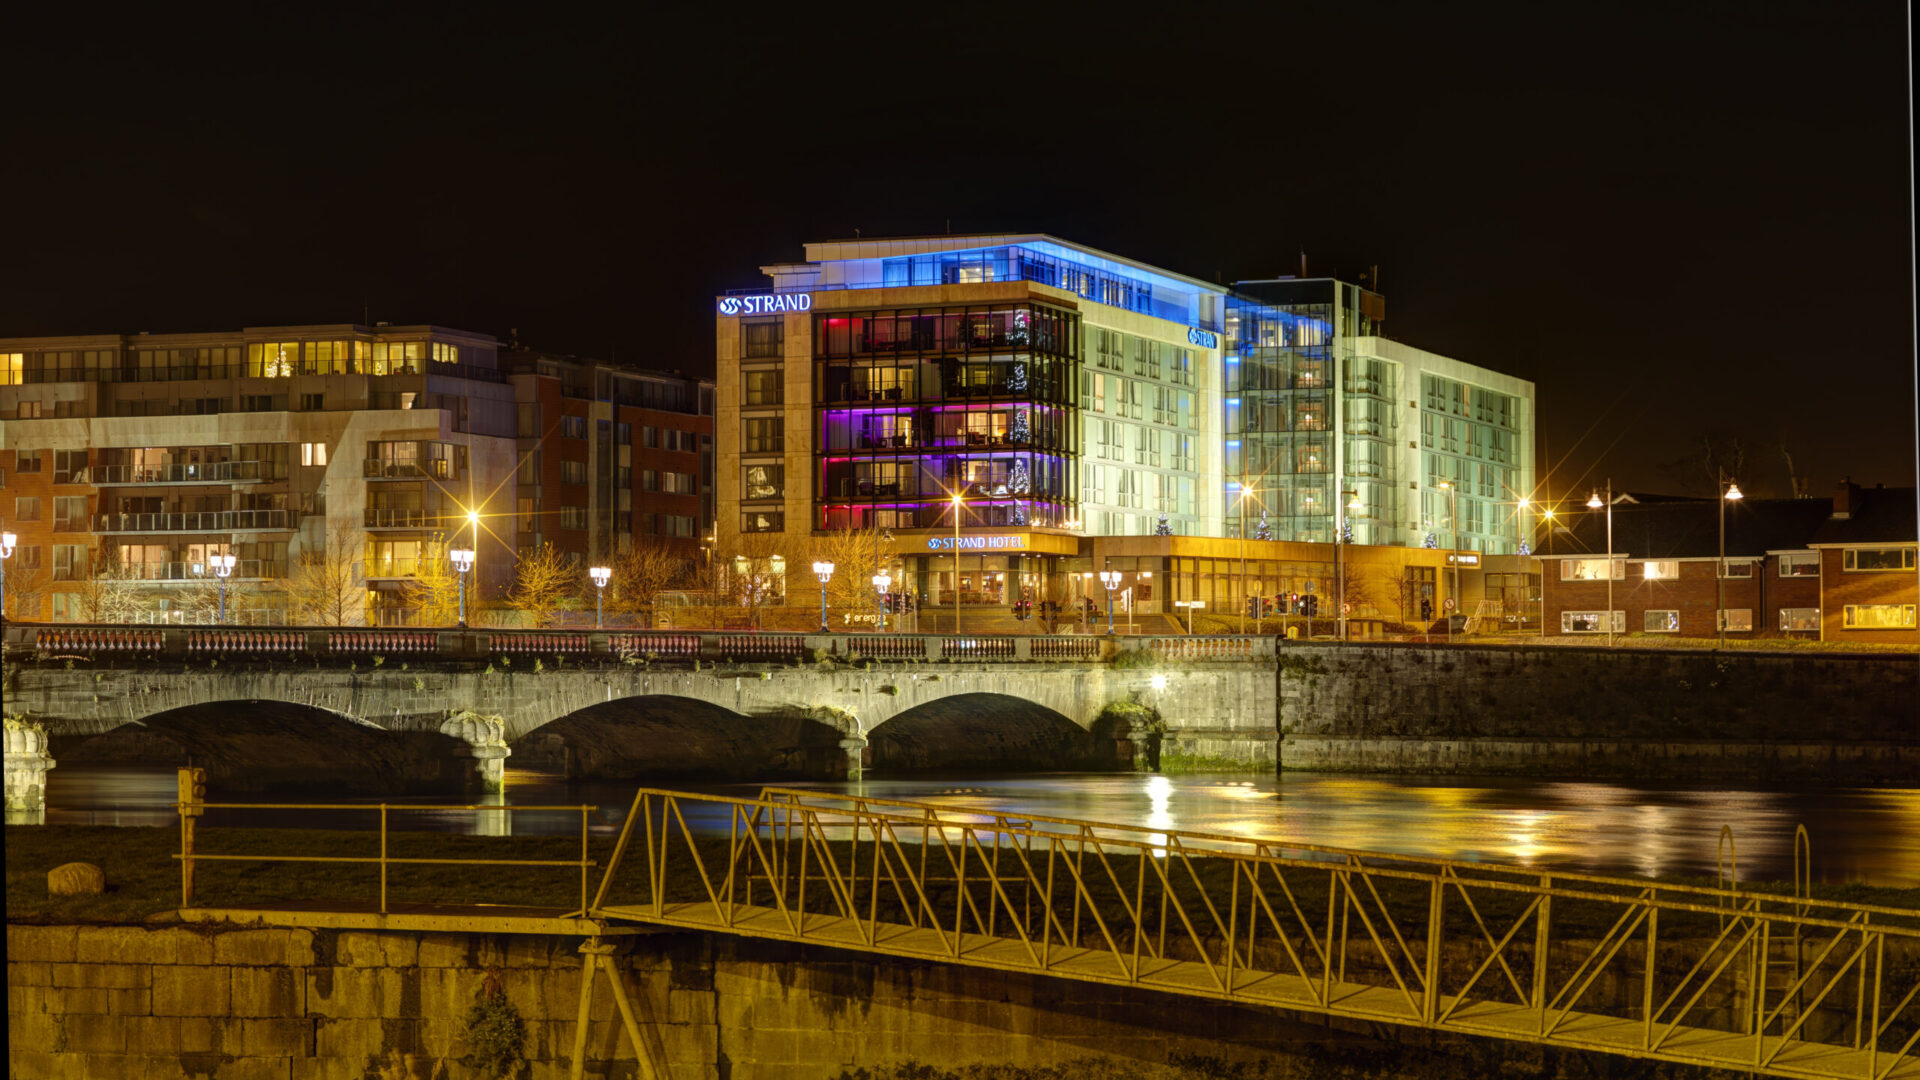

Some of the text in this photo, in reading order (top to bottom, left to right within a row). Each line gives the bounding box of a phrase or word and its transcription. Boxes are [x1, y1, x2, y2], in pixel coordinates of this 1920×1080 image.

[744, 294, 811, 314] STRAND
[943, 536, 1025, 549] STRAND HOTEL
